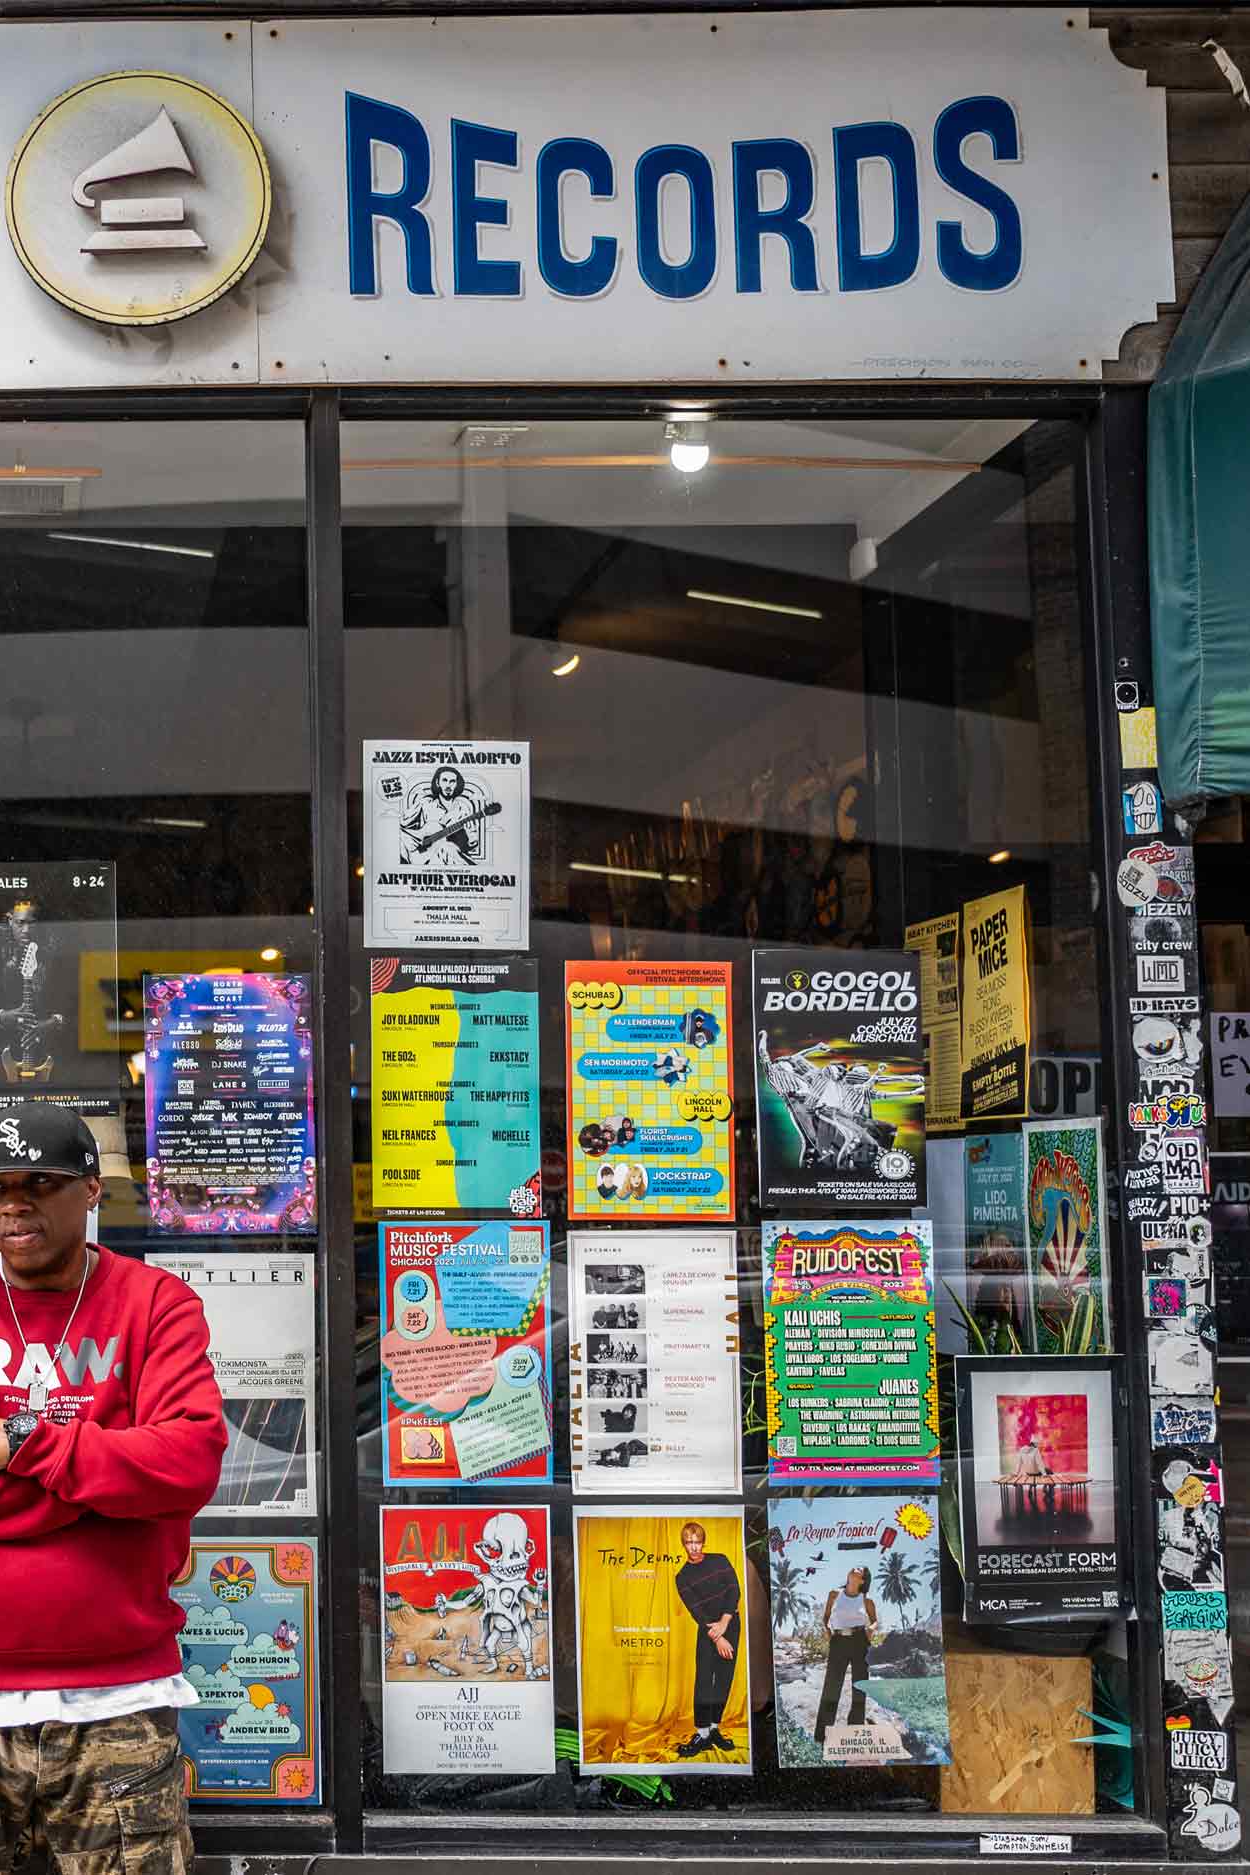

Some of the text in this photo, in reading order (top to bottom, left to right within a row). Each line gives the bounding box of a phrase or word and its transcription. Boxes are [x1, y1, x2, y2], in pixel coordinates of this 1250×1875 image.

[345, 91, 1022, 297] RECORDS
[372, 752, 414, 764] JAZZ
[461, 753, 521, 765] MORTO
[377, 874, 444, 886] ARTHUR
[970, 908, 1008, 954] PAPER
[1135, 941, 1192, 952] city crew
[977, 940, 1008, 980] MICE
[810, 971, 916, 992] GOGOL
[572, 991, 614, 999] SCHUBAS
[763, 991, 917, 1012] BORDELLO
[382, 1015, 440, 1025] JOY OLADOKUN
[473, 1015, 528, 1025] MATT MALTESE
[876, 1017, 916, 1026] JULY 27
[857, 1025, 916, 1034] CONCORD
[850, 1033, 916, 1042] MUSIC HALL
[172, 1041, 200, 1049] ALESSO
[382, 1051, 416, 1062] THE 502s
[212, 1061, 247, 1069] DJ SNAKE
[693, 1105, 714, 1113] HALL
[382, 1130, 436, 1141] NEIL FRANCES
[492, 1130, 530, 1141] MICHELLE
[382, 1169, 421, 1180] POOLSIDE
[653, 1172, 711, 1181] JOCKSTRAP
[985, 1190, 1006, 1205] LIDO
[1170, 1196, 1210, 1215] PIO+
[973, 1205, 1019, 1221] PIMIENTA
[390, 1231, 452, 1243] Pitchfork
[390, 1244, 504, 1256] MUSIC FESTIVAL
[390, 1258, 455, 1266] CHICAGO 2023
[792, 1248, 904, 1276] RUIDOFEST
[784, 1310, 841, 1326] KALI UCHIS
[879, 1380, 919, 1394] JUANES
[978, 1552, 1116, 1568] FORECAST FORM
[980, 1599, 1007, 1610] MCA
[620, 1639, 664, 1647] METRO
[234, 1656, 290, 1664] LORD HURON
[457, 1688, 479, 1703] AJJ
[416, 1712, 521, 1721] OPEN MIKE EAGLE
[230, 1726, 267, 1734] ANDREW
[1172, 1731, 1218, 1744] JUICY
[828, 1745, 900, 1754] SLEEPING VILLAGE
[1175, 1744, 1222, 1756] JUICY
[1179, 1756, 1225, 1768] JUICY
[1201, 1815, 1240, 1837] Dolce
